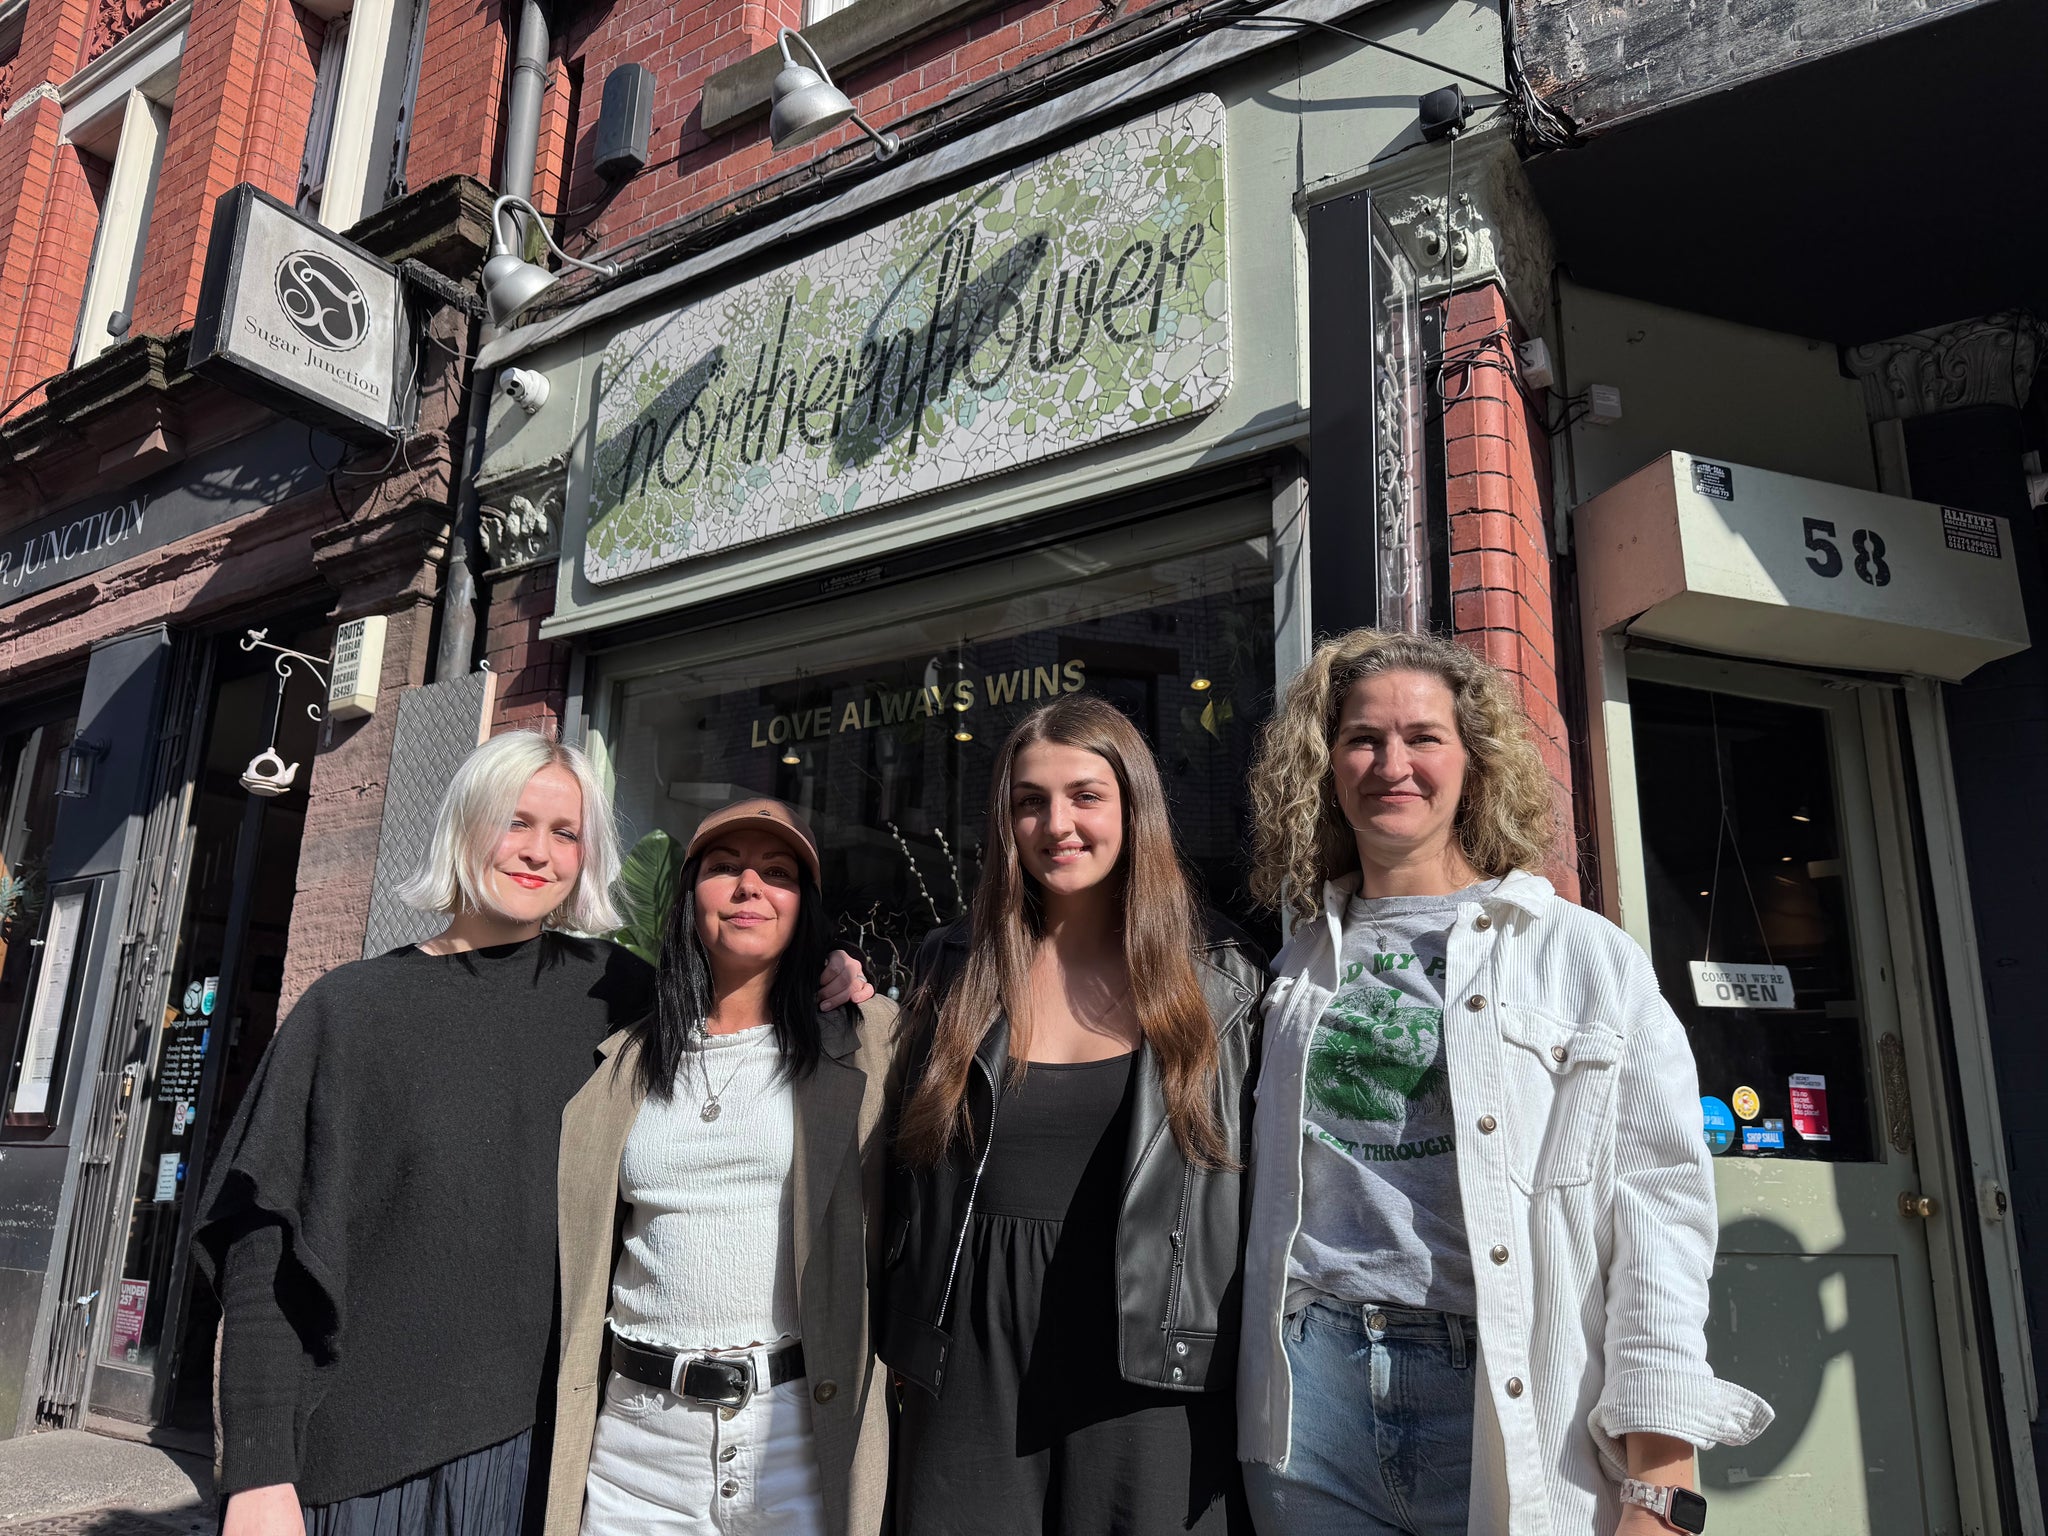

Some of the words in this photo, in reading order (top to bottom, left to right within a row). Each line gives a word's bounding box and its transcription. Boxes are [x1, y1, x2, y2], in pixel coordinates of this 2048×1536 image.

[244, 315, 300, 356] Sugar
[304, 347, 380, 396] Junction
[1944, 509, 1995, 529] ALLTITE
[13, 493, 149, 588] JUNCTION
[1802, 516, 1891, 587] 58
[338, 620, 365, 643] PROTEC
[337, 639, 361, 654] BURGLAR
[337, 650, 359, 665] ALARMS
[751, 706, 832, 748] LOVE
[838, 678, 975, 734] ALWAYS
[985, 658, 1086, 706] WINS
[1373, 952, 1418, 976] MY
[1423, 956, 1446, 980] P
[1701, 972, 1732, 983] COME
[1735, 973, 1747, 983] IN
[1751, 973, 1784, 984] WE'RE
[1716, 983, 1778, 1002] OPEN
[1746, 1132, 1761, 1143] SHOP
[1762, 1132, 1781, 1143] SMALL
[1362, 1134, 1456, 1162] THROUGH
[120, 1294, 133, 1306] 25?
[121, 1283, 146, 1297] UNDER
